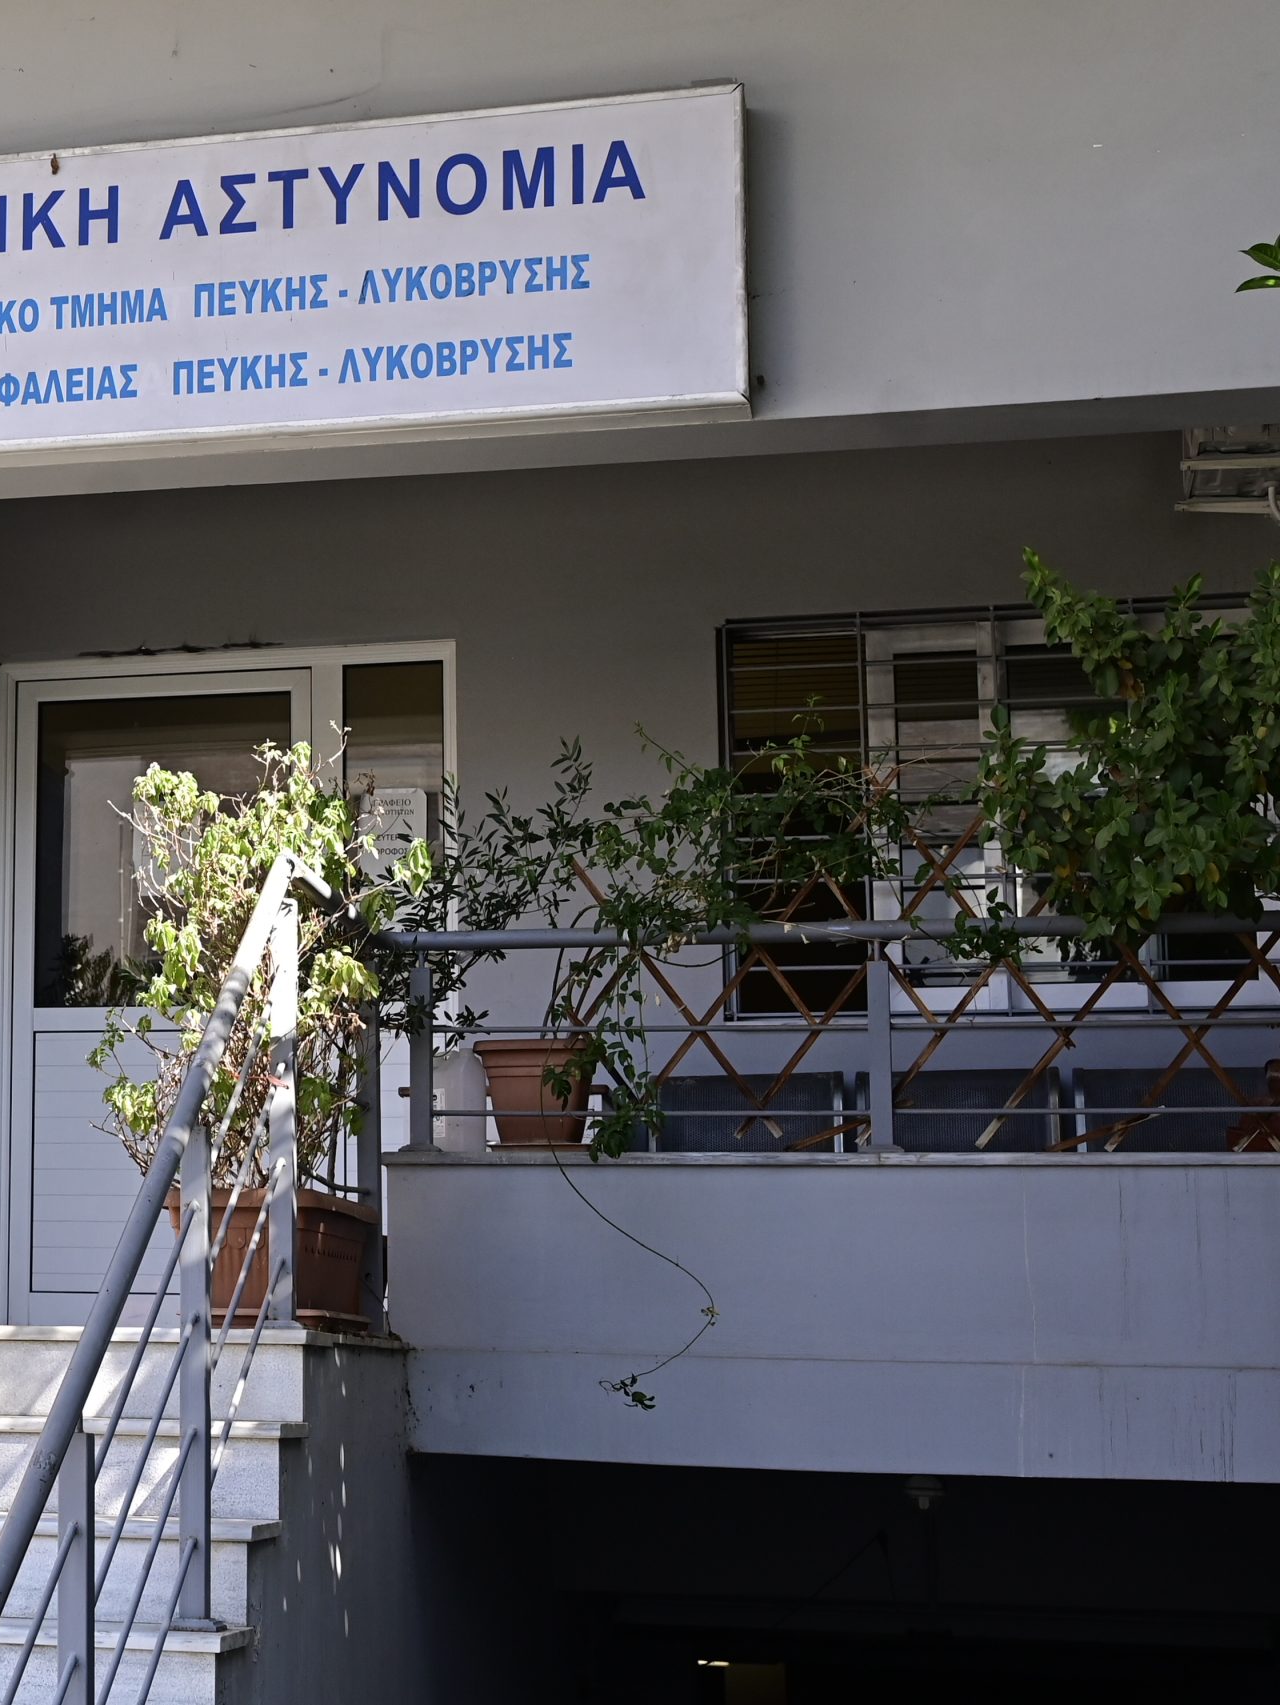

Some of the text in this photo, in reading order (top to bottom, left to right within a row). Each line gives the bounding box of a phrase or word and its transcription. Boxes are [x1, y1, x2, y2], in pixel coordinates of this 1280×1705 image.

[159, 140, 646, 241] ΑΣΤΥΝΟΜΙΑ
[49, 287, 168, 331] ΤΜΗΜΑ
[193, 274, 329, 319] ΠΕΥΚΗΣ
[358, 253, 591, 305] ΛΥΚΟΒΡΥΣΗΣ
[172, 351, 309, 396] ΠΕΥΚΗΣ
[337, 331, 574, 385] ΛΥΚΟΒΡΥΣΗΣ
